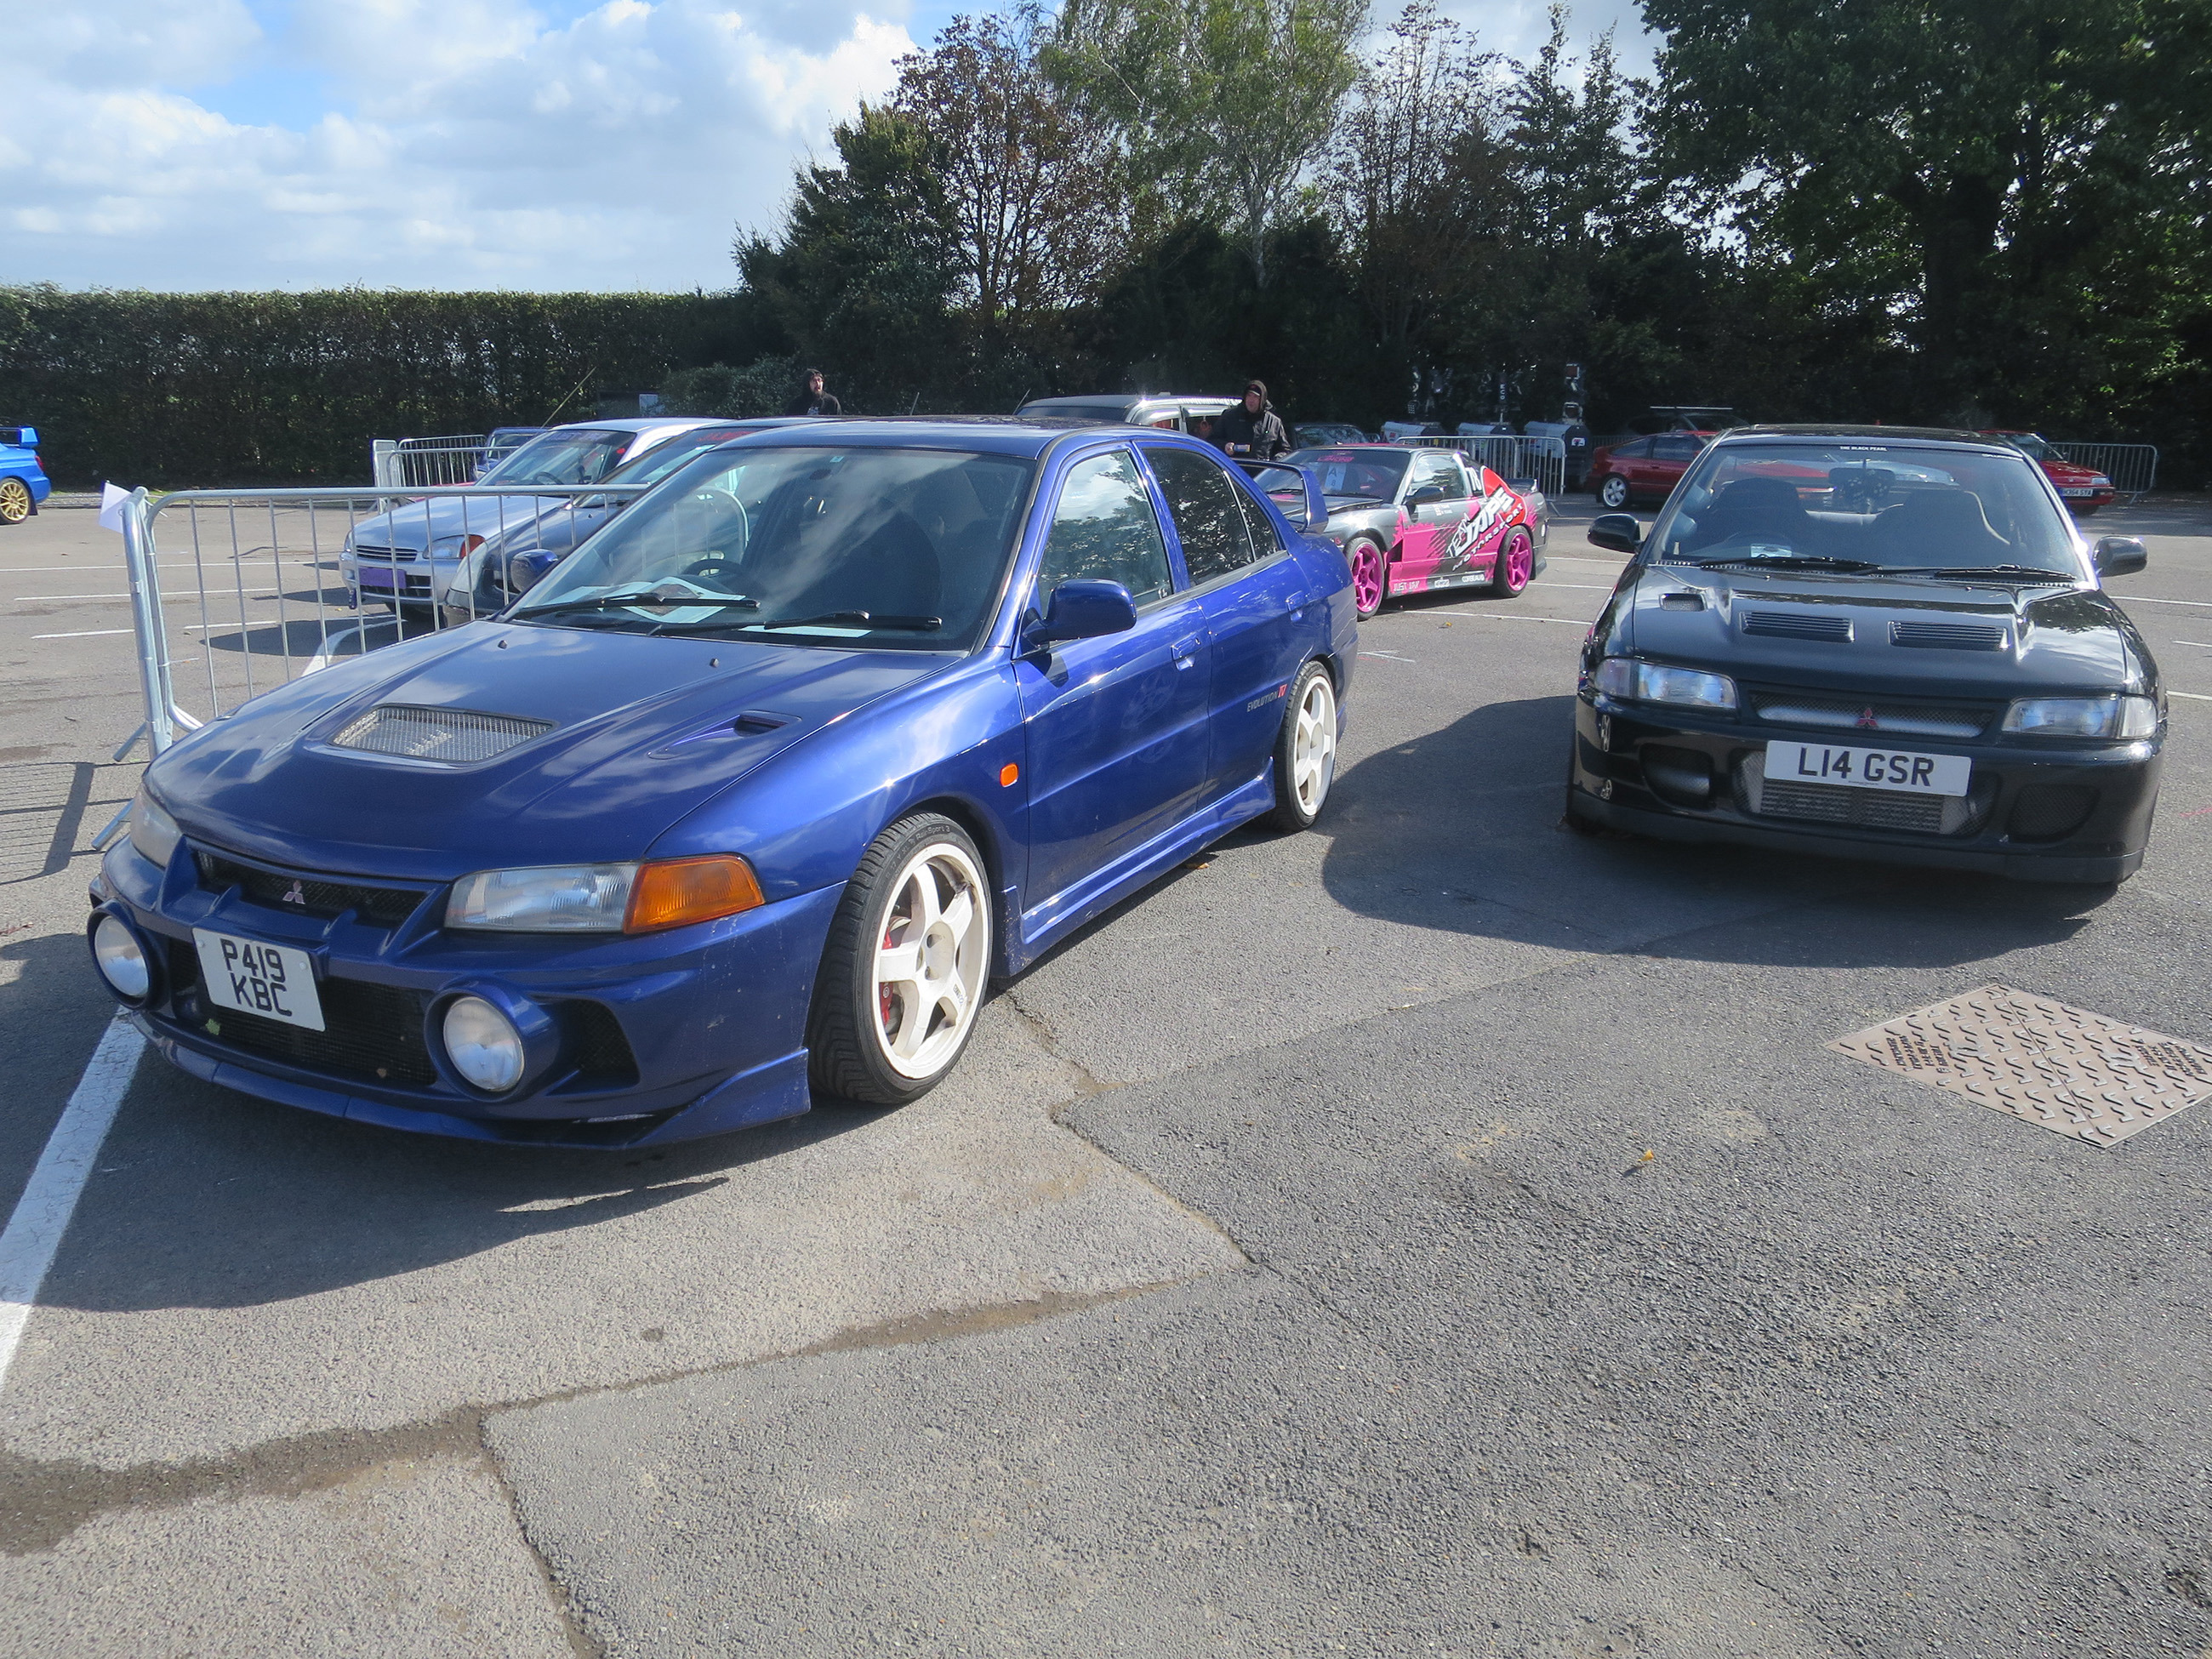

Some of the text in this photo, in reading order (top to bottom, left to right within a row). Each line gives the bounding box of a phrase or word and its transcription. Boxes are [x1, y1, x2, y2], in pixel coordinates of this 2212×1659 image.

[1328, 467, 1337, 477] A
[1451, 503, 1524, 572] MOTORSPORT
[1454, 487, 1515, 557] JAPS
[1246, 691, 1279, 713] EVOLUTION
[1798, 747, 1935, 787] L14 GSR
[219, 938, 286, 983] P419
[230, 972, 293, 1018] KBC
